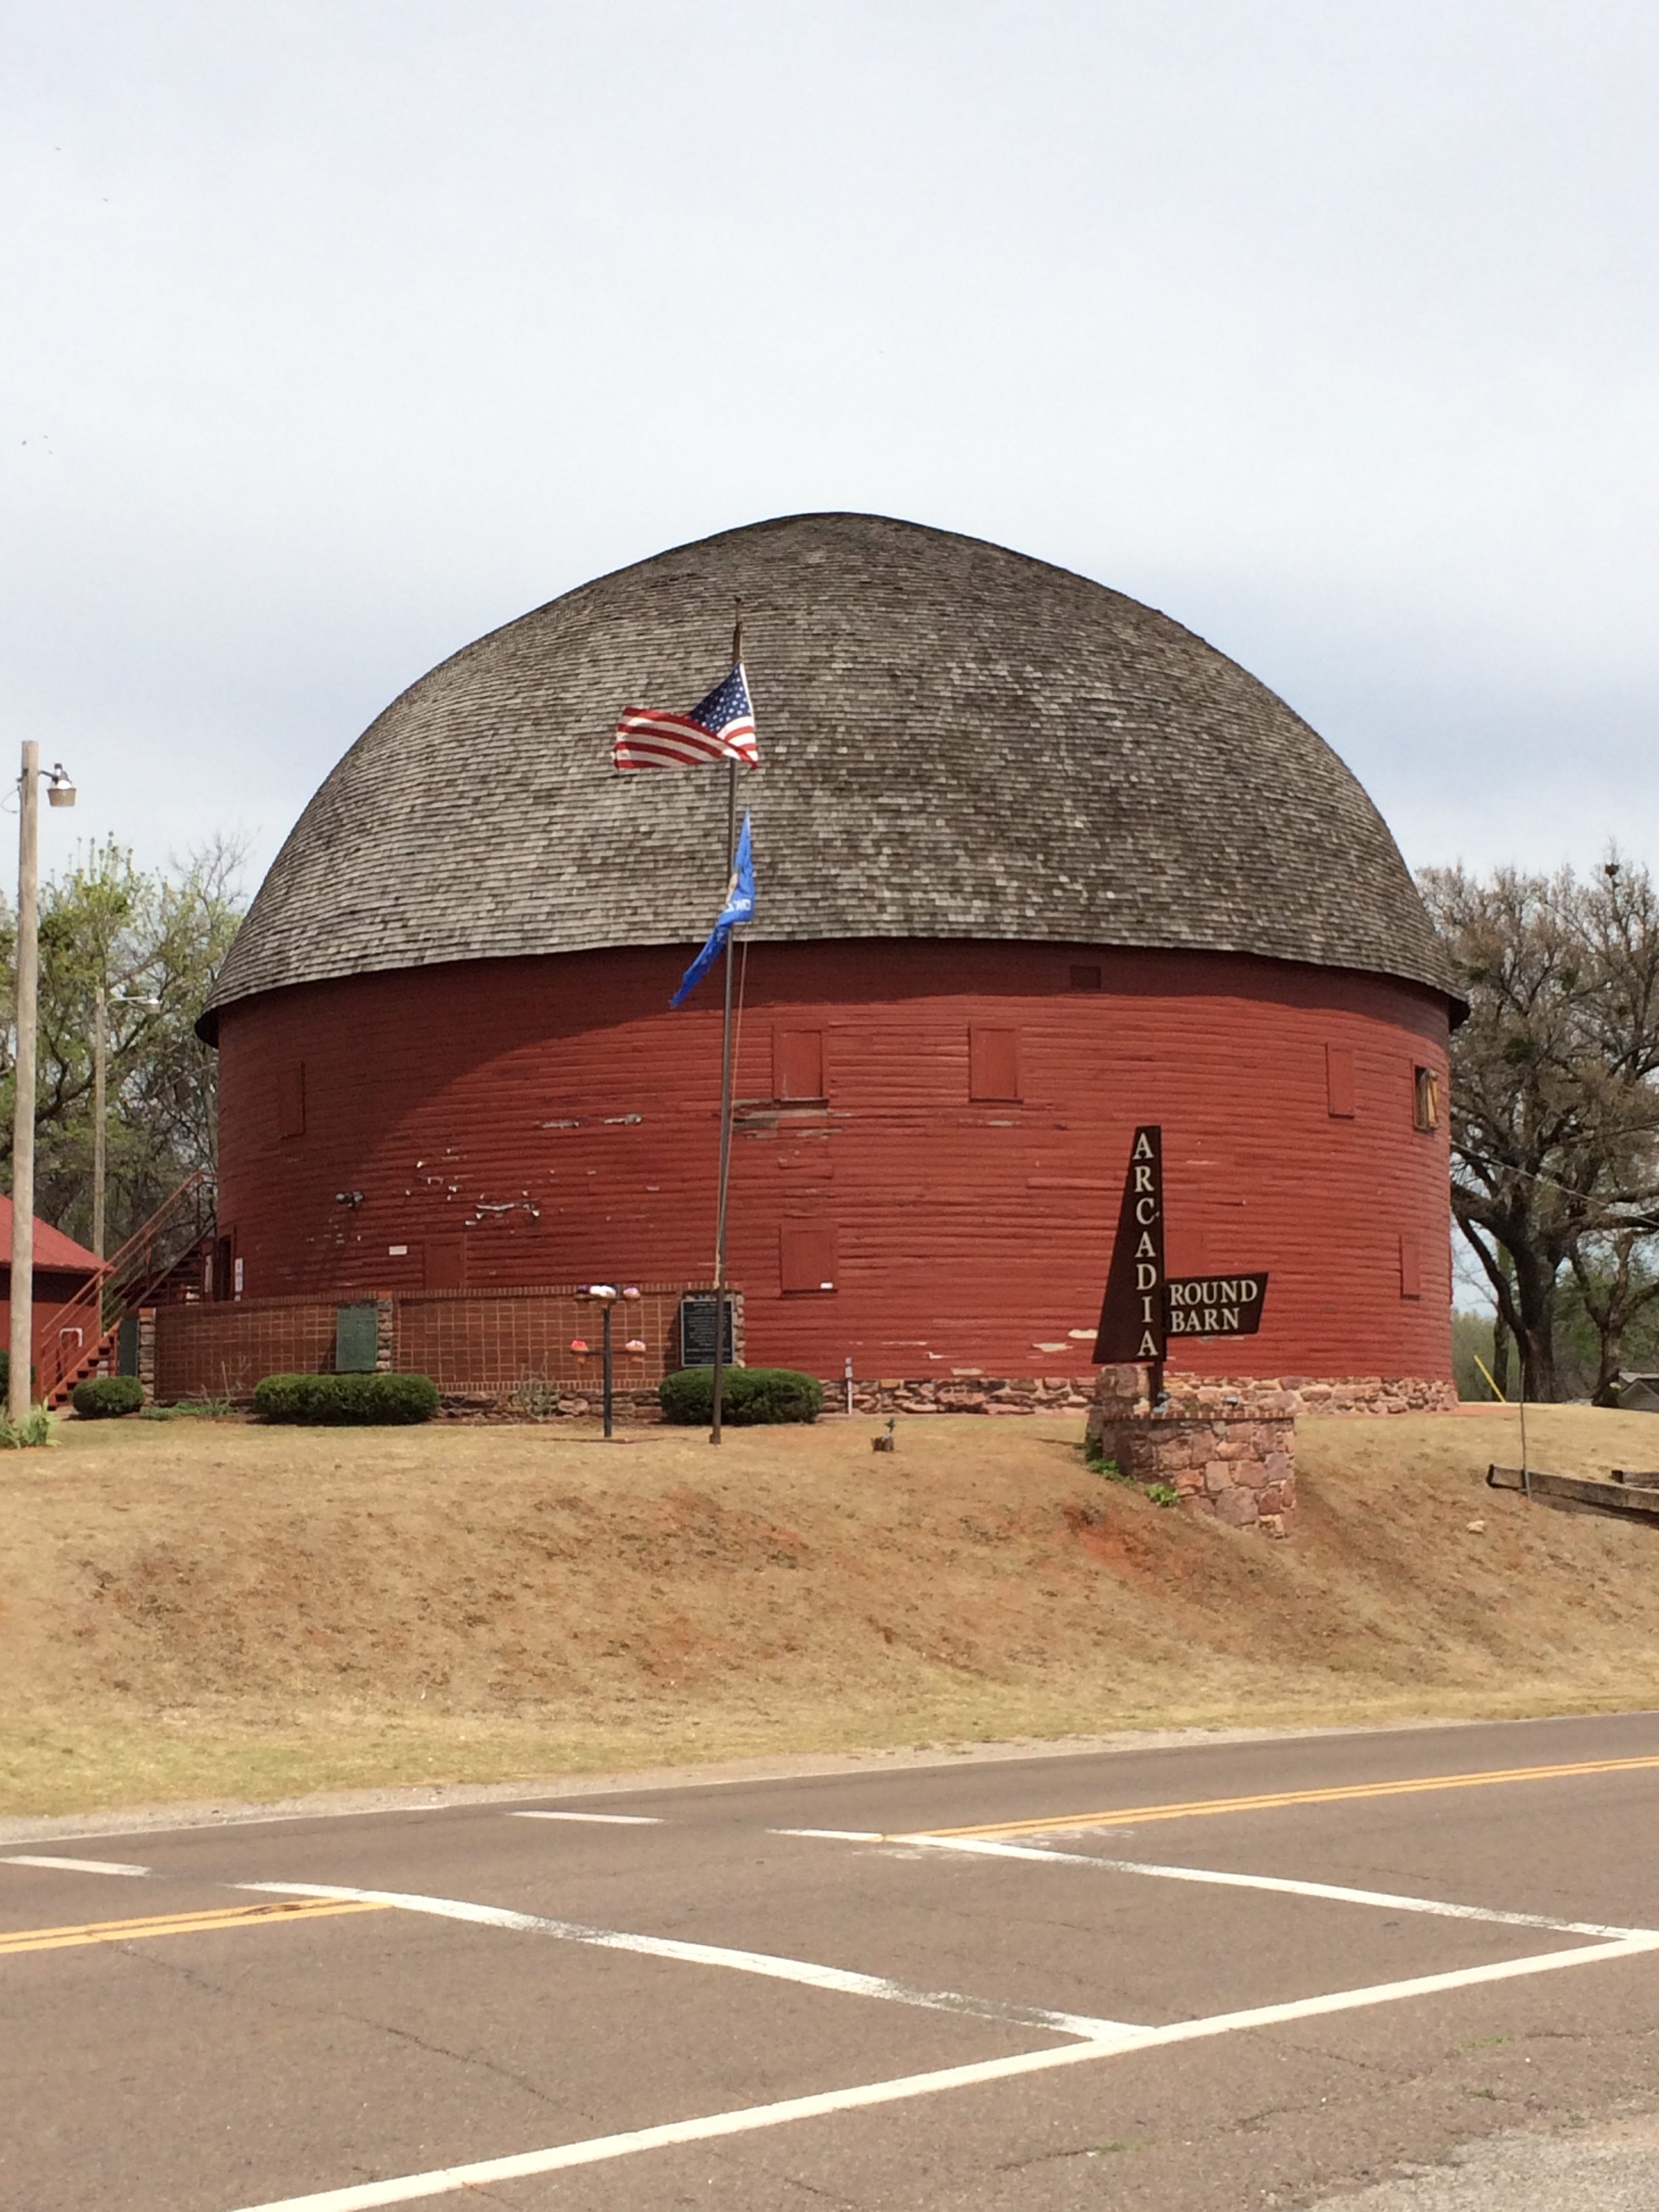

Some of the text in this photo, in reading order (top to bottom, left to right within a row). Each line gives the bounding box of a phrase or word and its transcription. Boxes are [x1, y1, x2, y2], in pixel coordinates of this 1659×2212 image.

[1132, 1132, 1158, 1356] ARCADIA
[1170, 1279, 1258, 1306] ROUND
[1170, 1307, 1240, 1333] BARN
